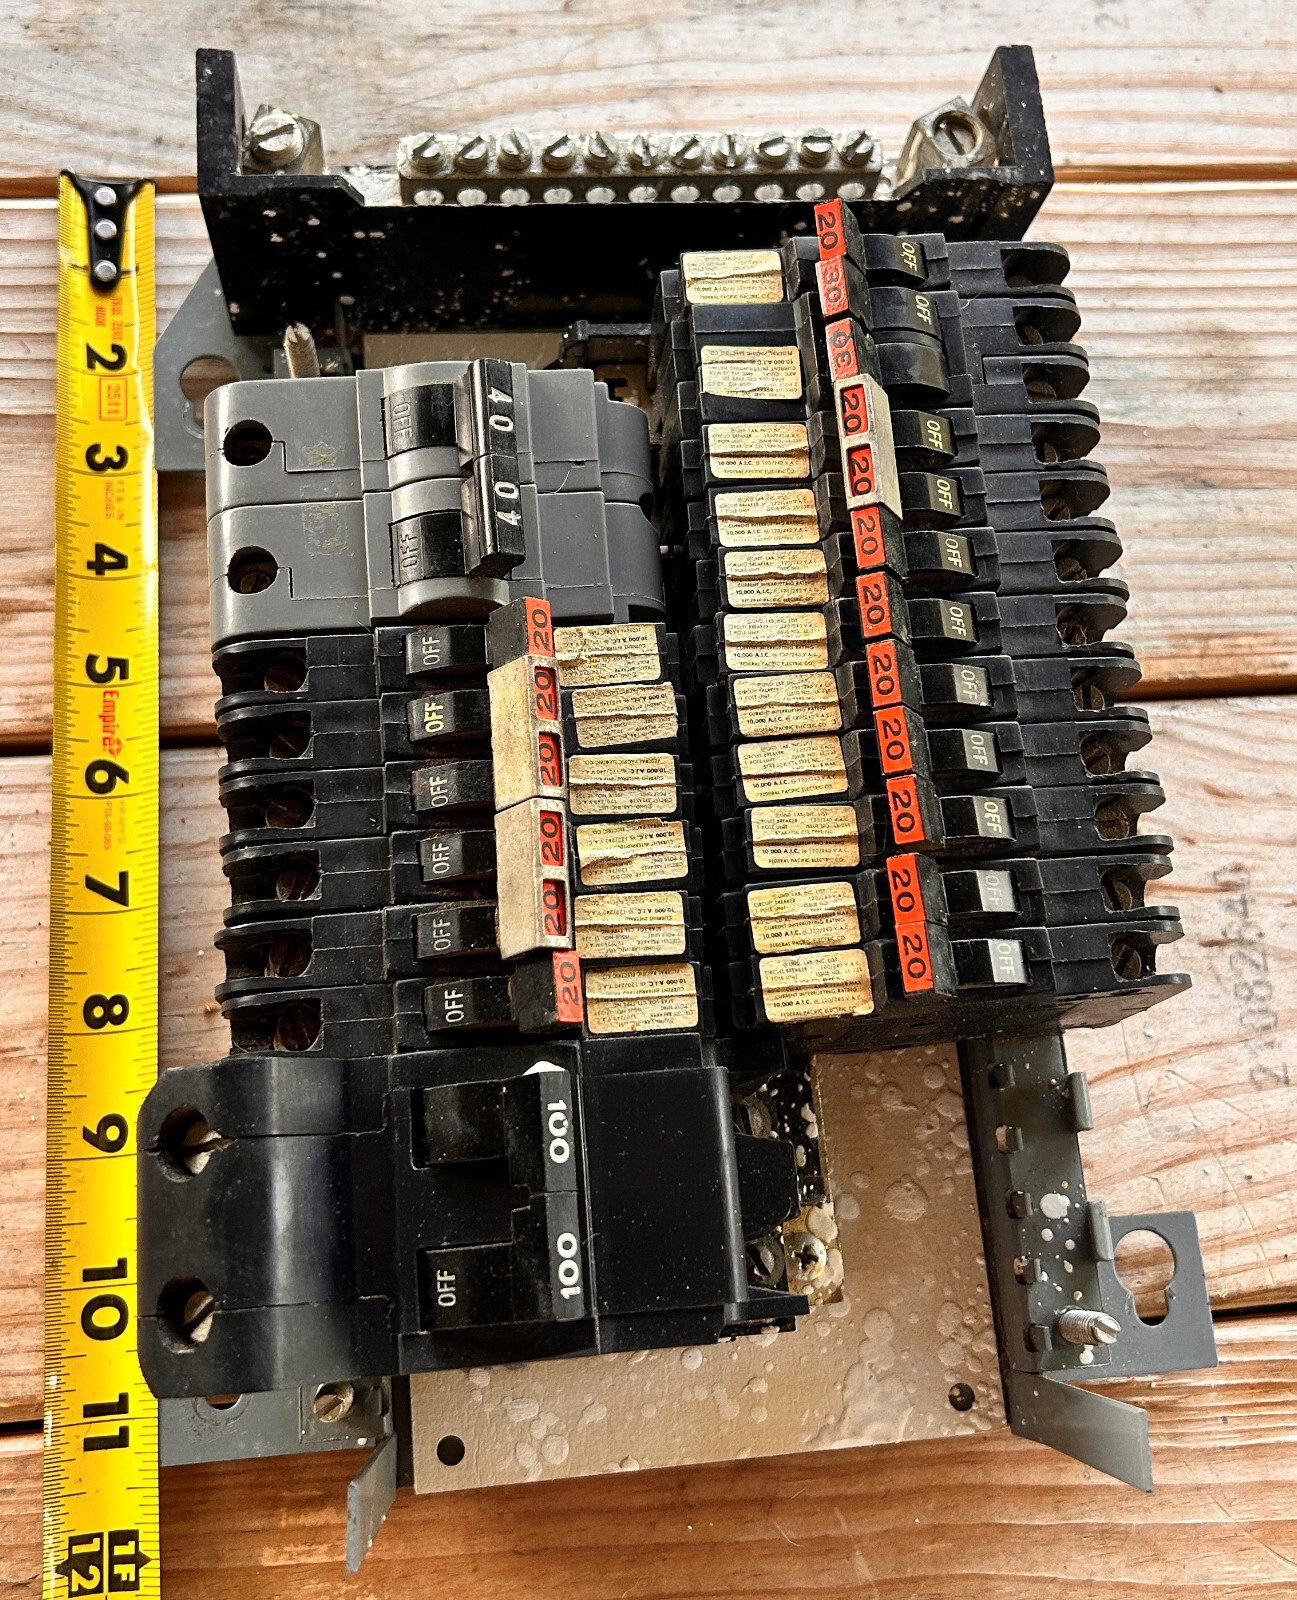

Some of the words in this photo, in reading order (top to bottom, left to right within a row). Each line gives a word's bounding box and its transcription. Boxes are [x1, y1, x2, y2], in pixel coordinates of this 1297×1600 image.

[818, 211, 838, 250] 20
[901, 242, 917, 272] OFF
[824, 268, 842, 303] 30
[914, 294, 932, 325] OFF
[86, 342, 128, 371] 2
[392, 401, 412, 438] OFF
[488, 387, 514, 432] 40
[841, 393, 862, 432] 20
[926, 419, 943, 450] OFF
[85, 443, 129, 474] 3
[851, 456, 872, 495] 20
[494, 481, 522, 526] 40
[936, 479, 952, 510] OFF
[399, 533, 418, 568] OFF
[858, 515, 878, 556] 20
[945, 537, 963, 568] OFF
[87, 542, 128, 576] 4
[863, 583, 885, 624] 20
[949, 606, 967, 637] OFF
[532, 608, 548, 650] 20
[85, 653, 129, 684] 5
[422, 636, 440, 666] OFF
[535, 670, 553, 713] 20
[872, 653, 894, 696] 20
[960, 669, 978, 701] OFF
[99, 690, 119, 752] Empire
[424, 702, 444, 733] OFF
[882, 718, 905, 761] 20
[970, 734, 989, 766] OFF
[85, 759, 129, 795] 6
[539, 742, 556, 786] 20
[430, 776, 448, 808] OFF
[891, 789, 915, 833] 20
[983, 801, 1002, 834] OFF
[432, 842, 450, 875] OFF
[541, 817, 560, 863] 20
[85, 870, 129, 907] 7
[891, 868, 915, 912] 20
[985, 875, 1000, 905] OFF
[543, 890, 562, 936] 20
[433, 918, 450, 951] OFF
[902, 934, 926, 979] 20
[997, 942, 1016, 976] OFF
[560, 961, 579, 1006] 20
[83, 994, 129, 1029] 8
[444, 989, 464, 1023] OFF
[83, 1113, 128, 1153] 9
[547, 1100, 570, 1164] 100
[557, 1232, 581, 1300] 100
[81, 1257, 129, 1341] 10
[437, 1269, 456, 1308] OFF
[83, 1392, 129, 1452] 11
[71, 1537, 101, 1592] 12
[113, 1541, 136, 1582] 1F
